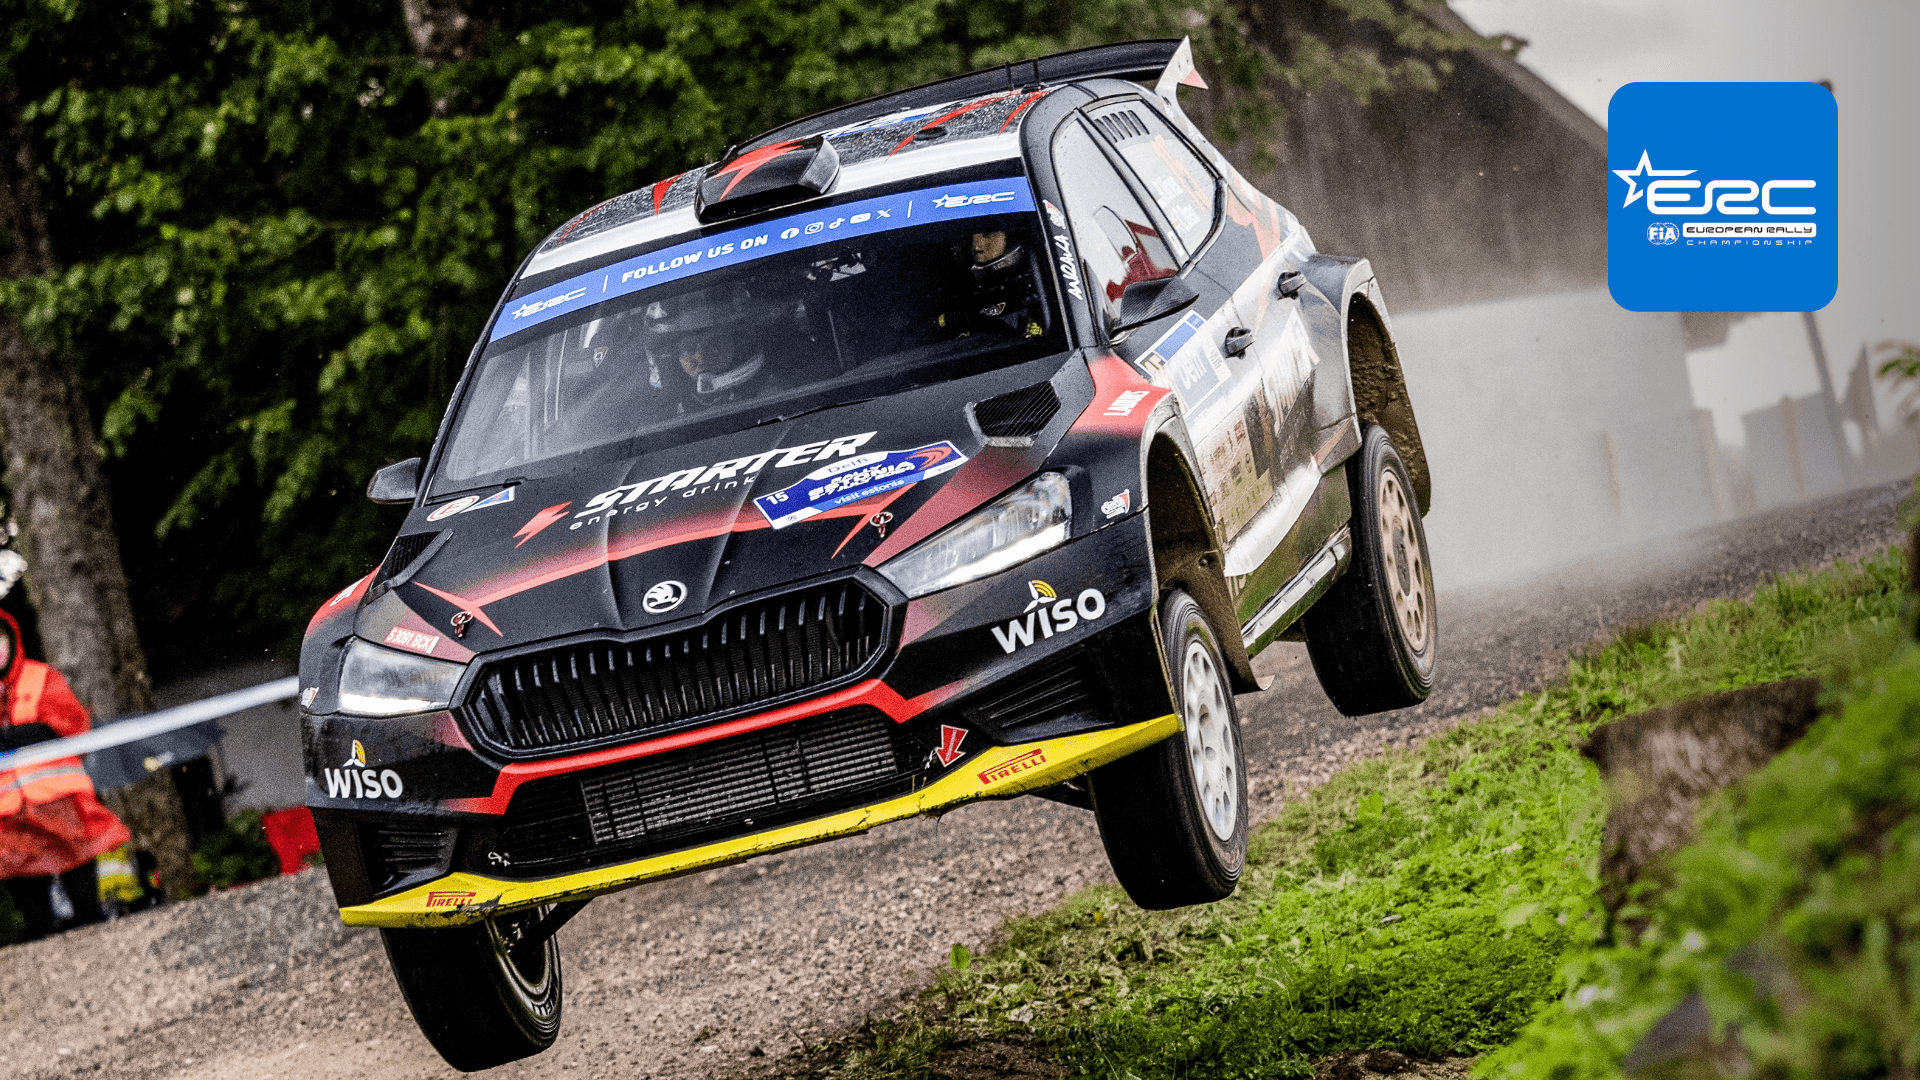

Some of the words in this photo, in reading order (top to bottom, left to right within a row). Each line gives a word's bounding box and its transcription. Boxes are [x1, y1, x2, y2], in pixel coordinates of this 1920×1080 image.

[943, 192, 1015, 208] ERC
[621, 251, 702, 283] FOLLOW
[707, 242, 734, 259] US
[740, 234, 769, 251] ON
[522, 287, 587, 318] ERC
[574, 431, 878, 519] STARTER
[828, 457, 869, 473] Delfi
[569, 497, 668, 530] energy
[685, 475, 757, 499] drink
[765, 491, 789, 505] 15
[834, 492, 861, 505] visit
[861, 479, 905, 496] estonia
[991, 588, 1107, 654] WISO
[977, 748, 1047, 785] PIRELLI
[324, 768, 403, 799] WISO
[426, 891, 477, 908] PIRELLI
